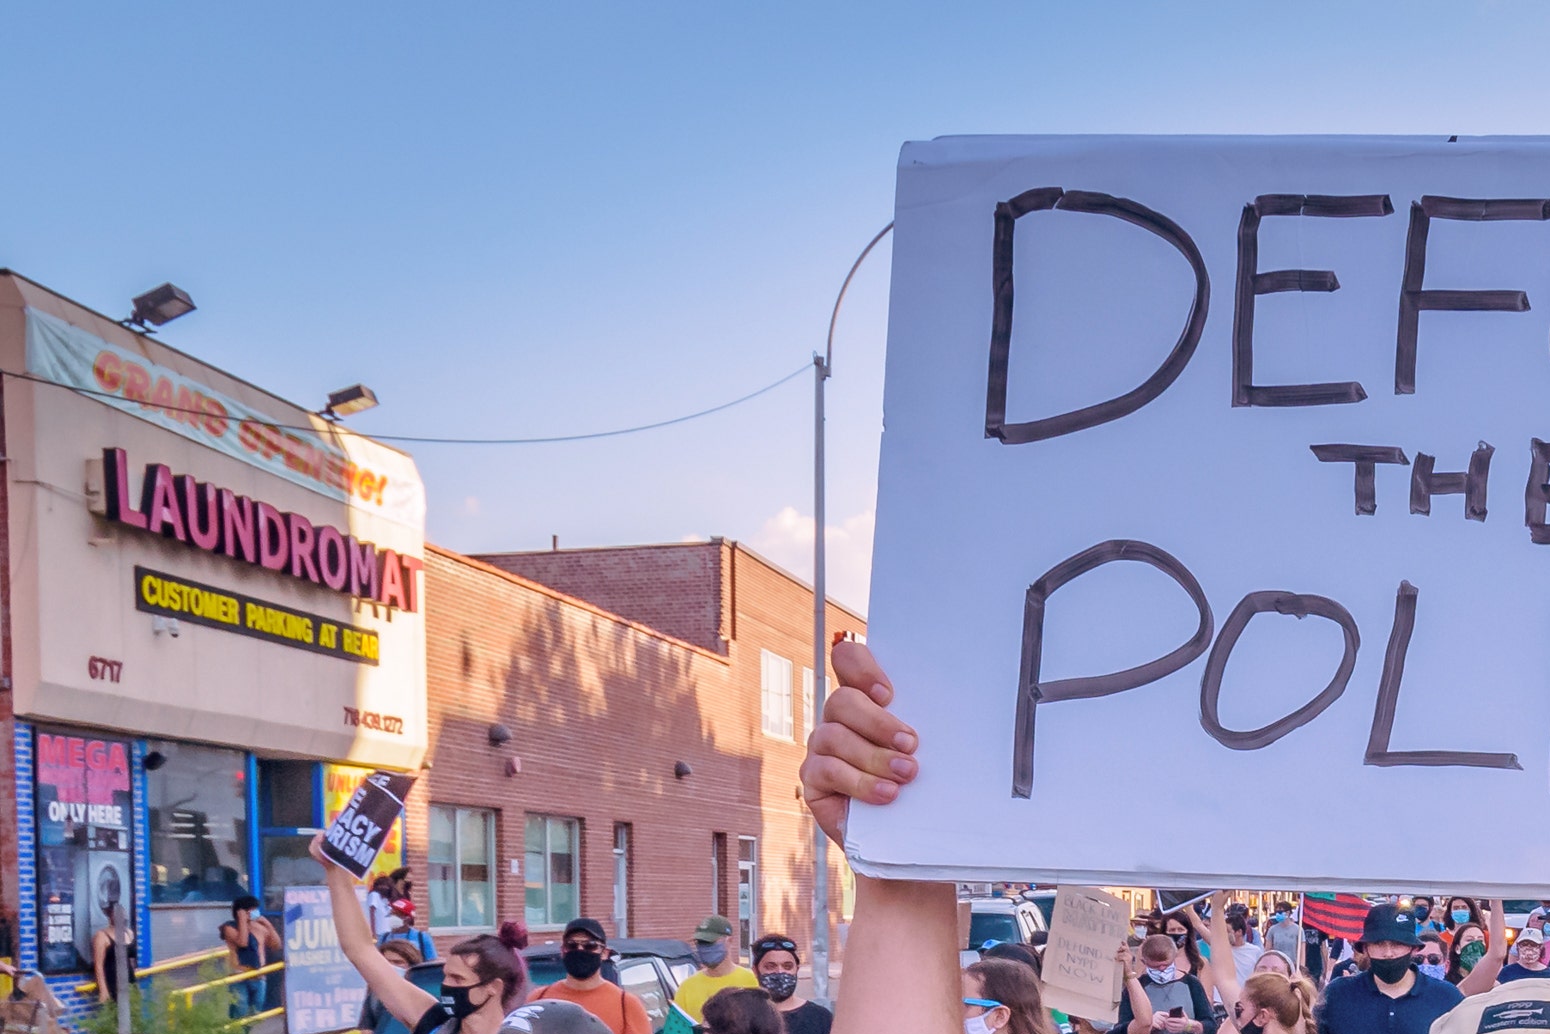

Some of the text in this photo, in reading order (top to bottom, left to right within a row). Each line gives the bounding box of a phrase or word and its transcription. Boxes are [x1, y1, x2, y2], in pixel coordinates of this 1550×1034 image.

[92, 350, 230, 438] GRAND
[103, 447, 424, 614] LAUNDROMAT
[141, 575, 379, 661] CUSTOMER PARKING AT REAR
[88, 655, 123, 684] 6717
[38, 733, 128, 774] MEGA
[48, 801, 123, 825] ONLY HERE
[1059, 963, 1105, 984] NOW
[1066, 952, 1098, 970] NYPD
[1484, 1017, 1549, 1030] western edition
